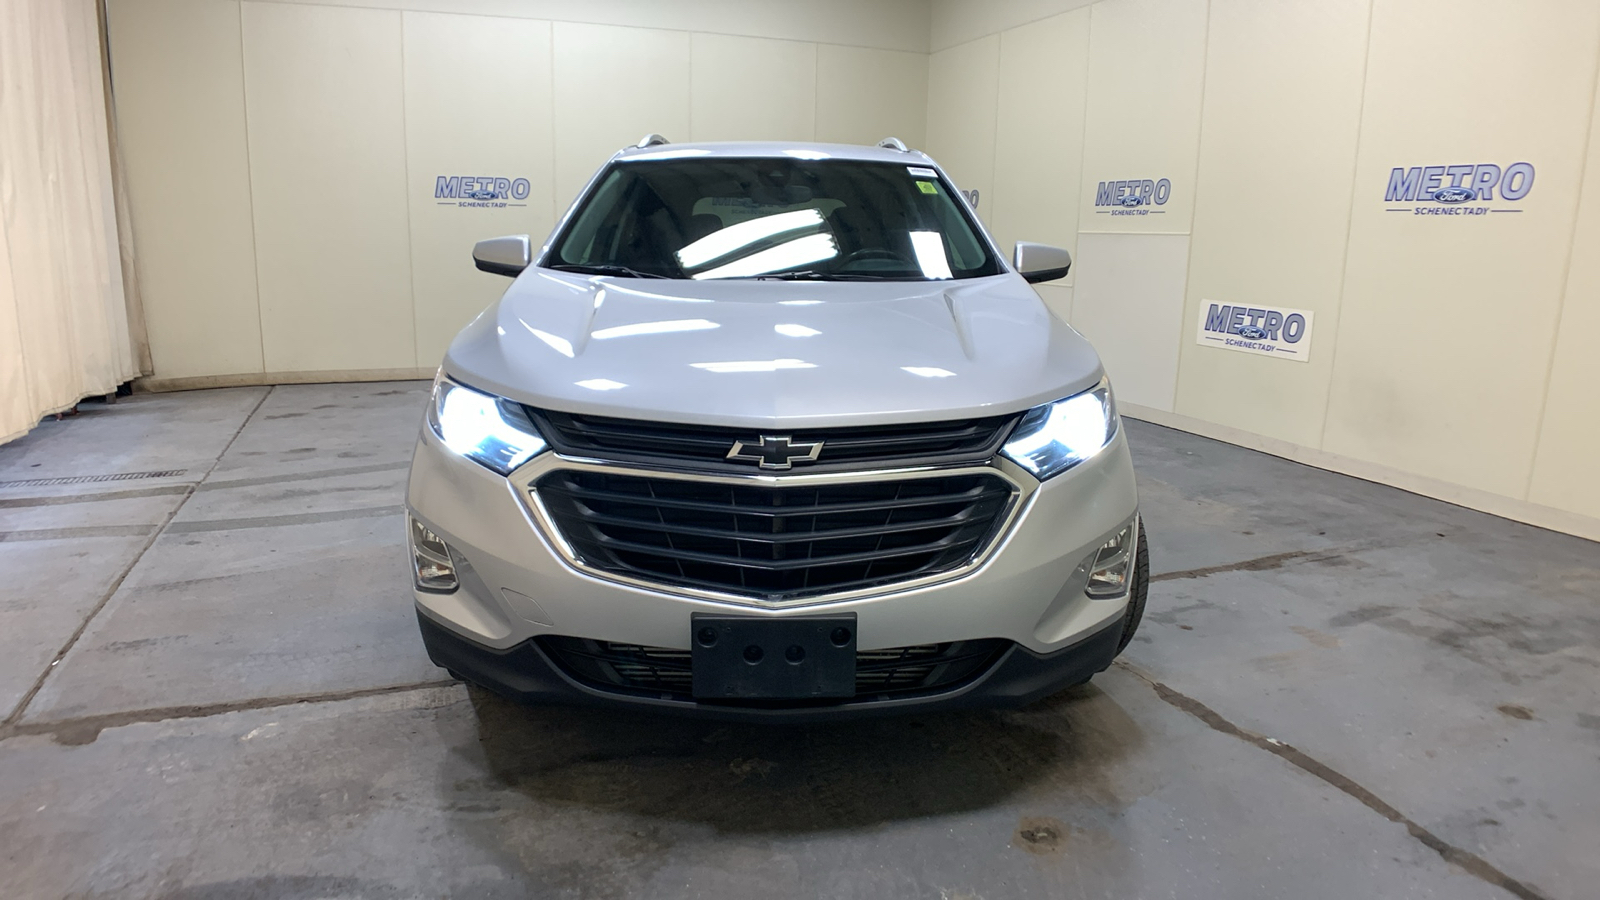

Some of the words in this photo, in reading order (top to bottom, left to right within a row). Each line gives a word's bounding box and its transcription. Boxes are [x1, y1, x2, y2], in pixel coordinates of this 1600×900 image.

[435, 176, 531, 200] METRO
[1095, 178, 1171, 206] METRO
[1384, 162, 1535, 201] METRO
[1414, 207, 1490, 215] SCHENECTADY
[1204, 303, 1306, 344] METRO
[1225, 338, 1276, 352] SCHENECTADY
